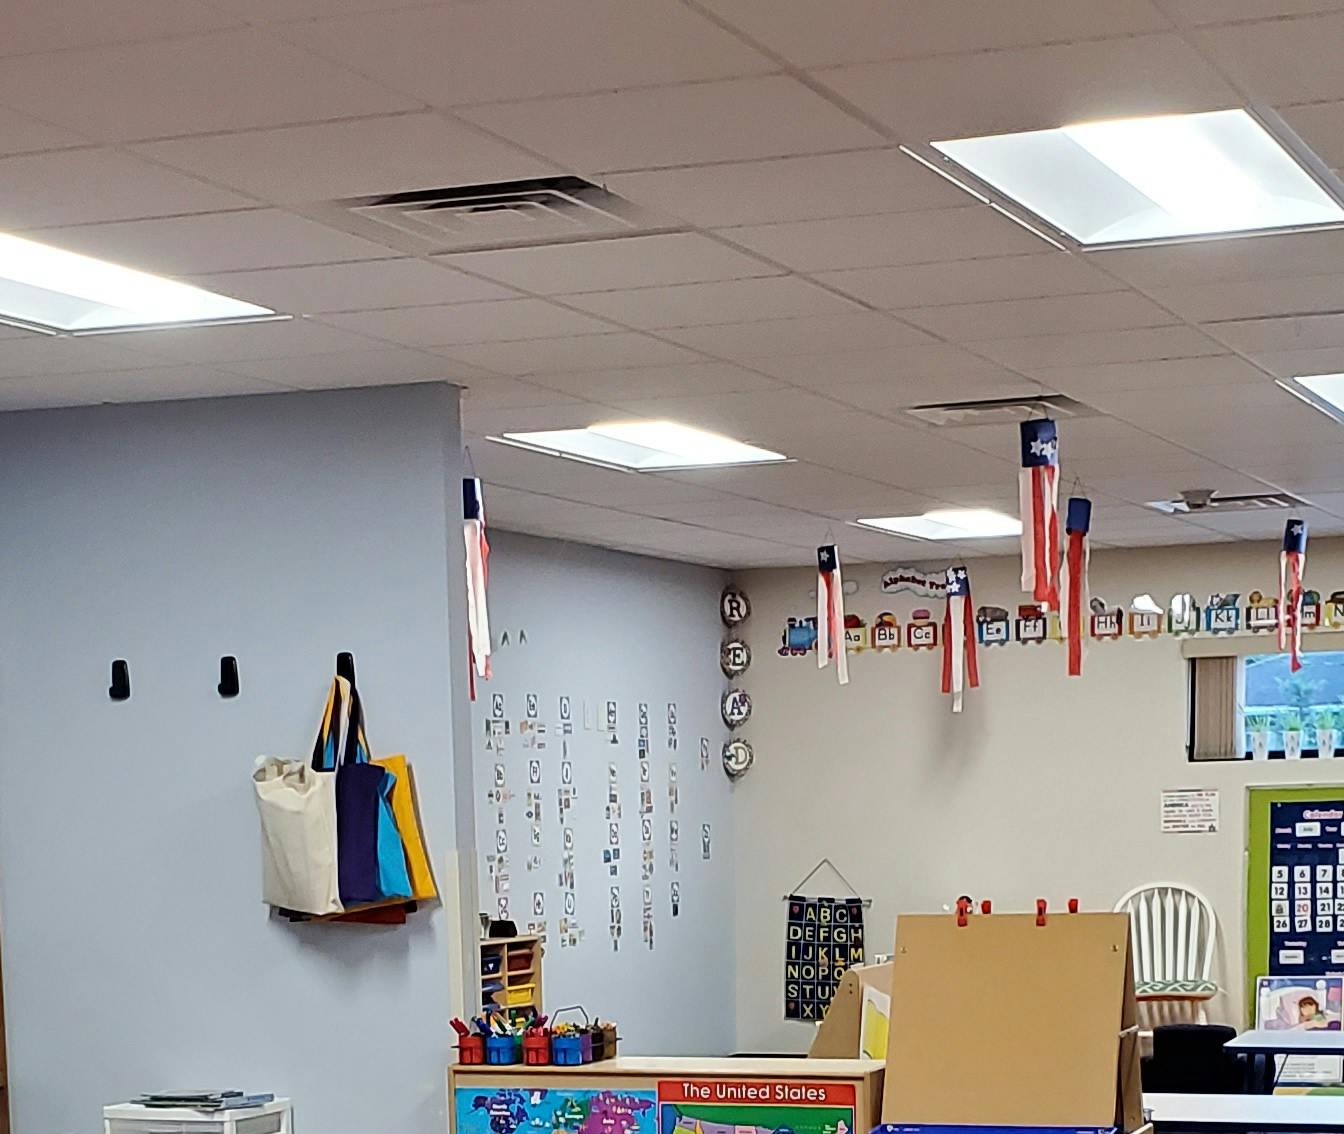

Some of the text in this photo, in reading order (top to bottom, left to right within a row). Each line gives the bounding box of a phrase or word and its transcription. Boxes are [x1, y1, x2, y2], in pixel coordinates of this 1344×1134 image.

[883, 575, 927, 589] Alphabet
[878, 627, 895, 641] Bb
[913, 628, 931, 640] Cc
[986, 622, 1002, 636] Ee
[1023, 619, 1038, 633] Ff
[1139, 613, 1151, 626] Ii
[1214, 609, 1232, 624] Kk
[1277, 870, 1283, 878] 5
[1300, 870, 1305, 878] 6
[1322, 869, 1327, 877] 7
[1275, 887, 1284, 895] 12
[1298, 887, 1307, 895] 13
[806, 906, 848, 923] A B C
[1297, 904, 1308, 912] 20
[1320, 903, 1330, 911] 21
[1276, 920, 1287, 928] 26
[1298, 919, 1307, 928] 27
[1319, 920, 1330, 928] 28
[789, 925, 862, 942] D E F G H
[803, 946, 813, 960] J
[818, 946, 828, 959] K
[850, 947, 863, 961] M
[787, 964, 799, 979] N
[802, 965, 814, 979] O
[819, 967, 829, 980] P
[787, 984, 829, 999] S T U
[803, 1004, 813, 1018] X
[682, 1083, 826, 1101] The United States
